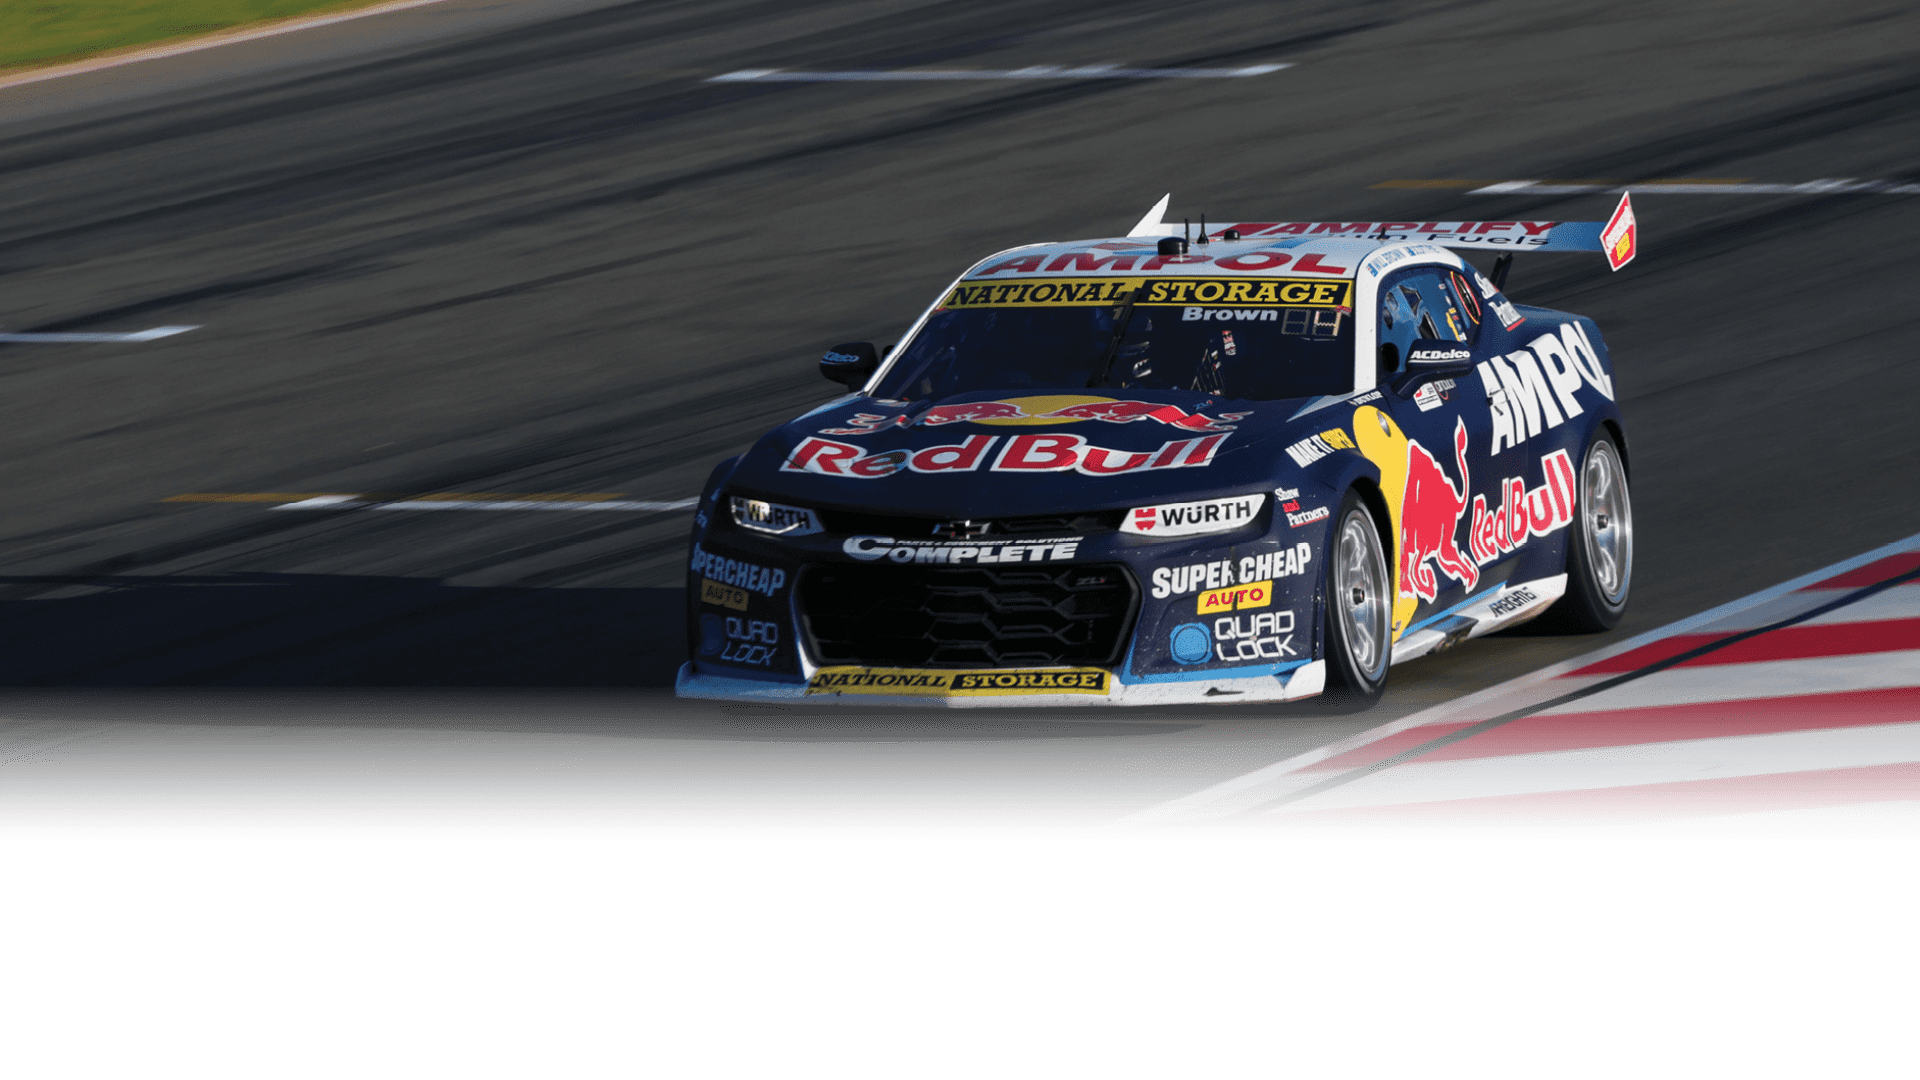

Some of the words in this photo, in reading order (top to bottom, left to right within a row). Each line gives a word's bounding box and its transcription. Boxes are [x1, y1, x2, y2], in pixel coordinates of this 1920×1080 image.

[1427, 234, 1550, 246] Fuels
[976, 250, 1348, 276] AMPOL
[947, 281, 1128, 306] NATIONAL
[1148, 281, 1340, 304] STORAGE
[1181, 306, 1278, 322] Brown
[1476, 320, 1615, 456] AMPOL
[779, 434, 1001, 479] Red
[989, 431, 1234, 477] Bull
[1274, 487, 1300, 502] Shaw
[1469, 478, 1514, 566] Red
[1508, 448, 1576, 550] Bull
[1162, 500, 1250, 527] WÜRTH
[1285, 506, 1330, 526] Partners
[843, 535, 1079, 564] COMPLETE
[1205, 588, 1264, 608] AUTO
[726, 616, 778, 644] QUAD
[1214, 610, 1295, 641] QUAD
[721, 641, 777, 666] LOCK
[1216, 634, 1297, 662] LOCK
[808, 672, 947, 688] NATIONAL
[961, 673, 1097, 688] STORAGE
